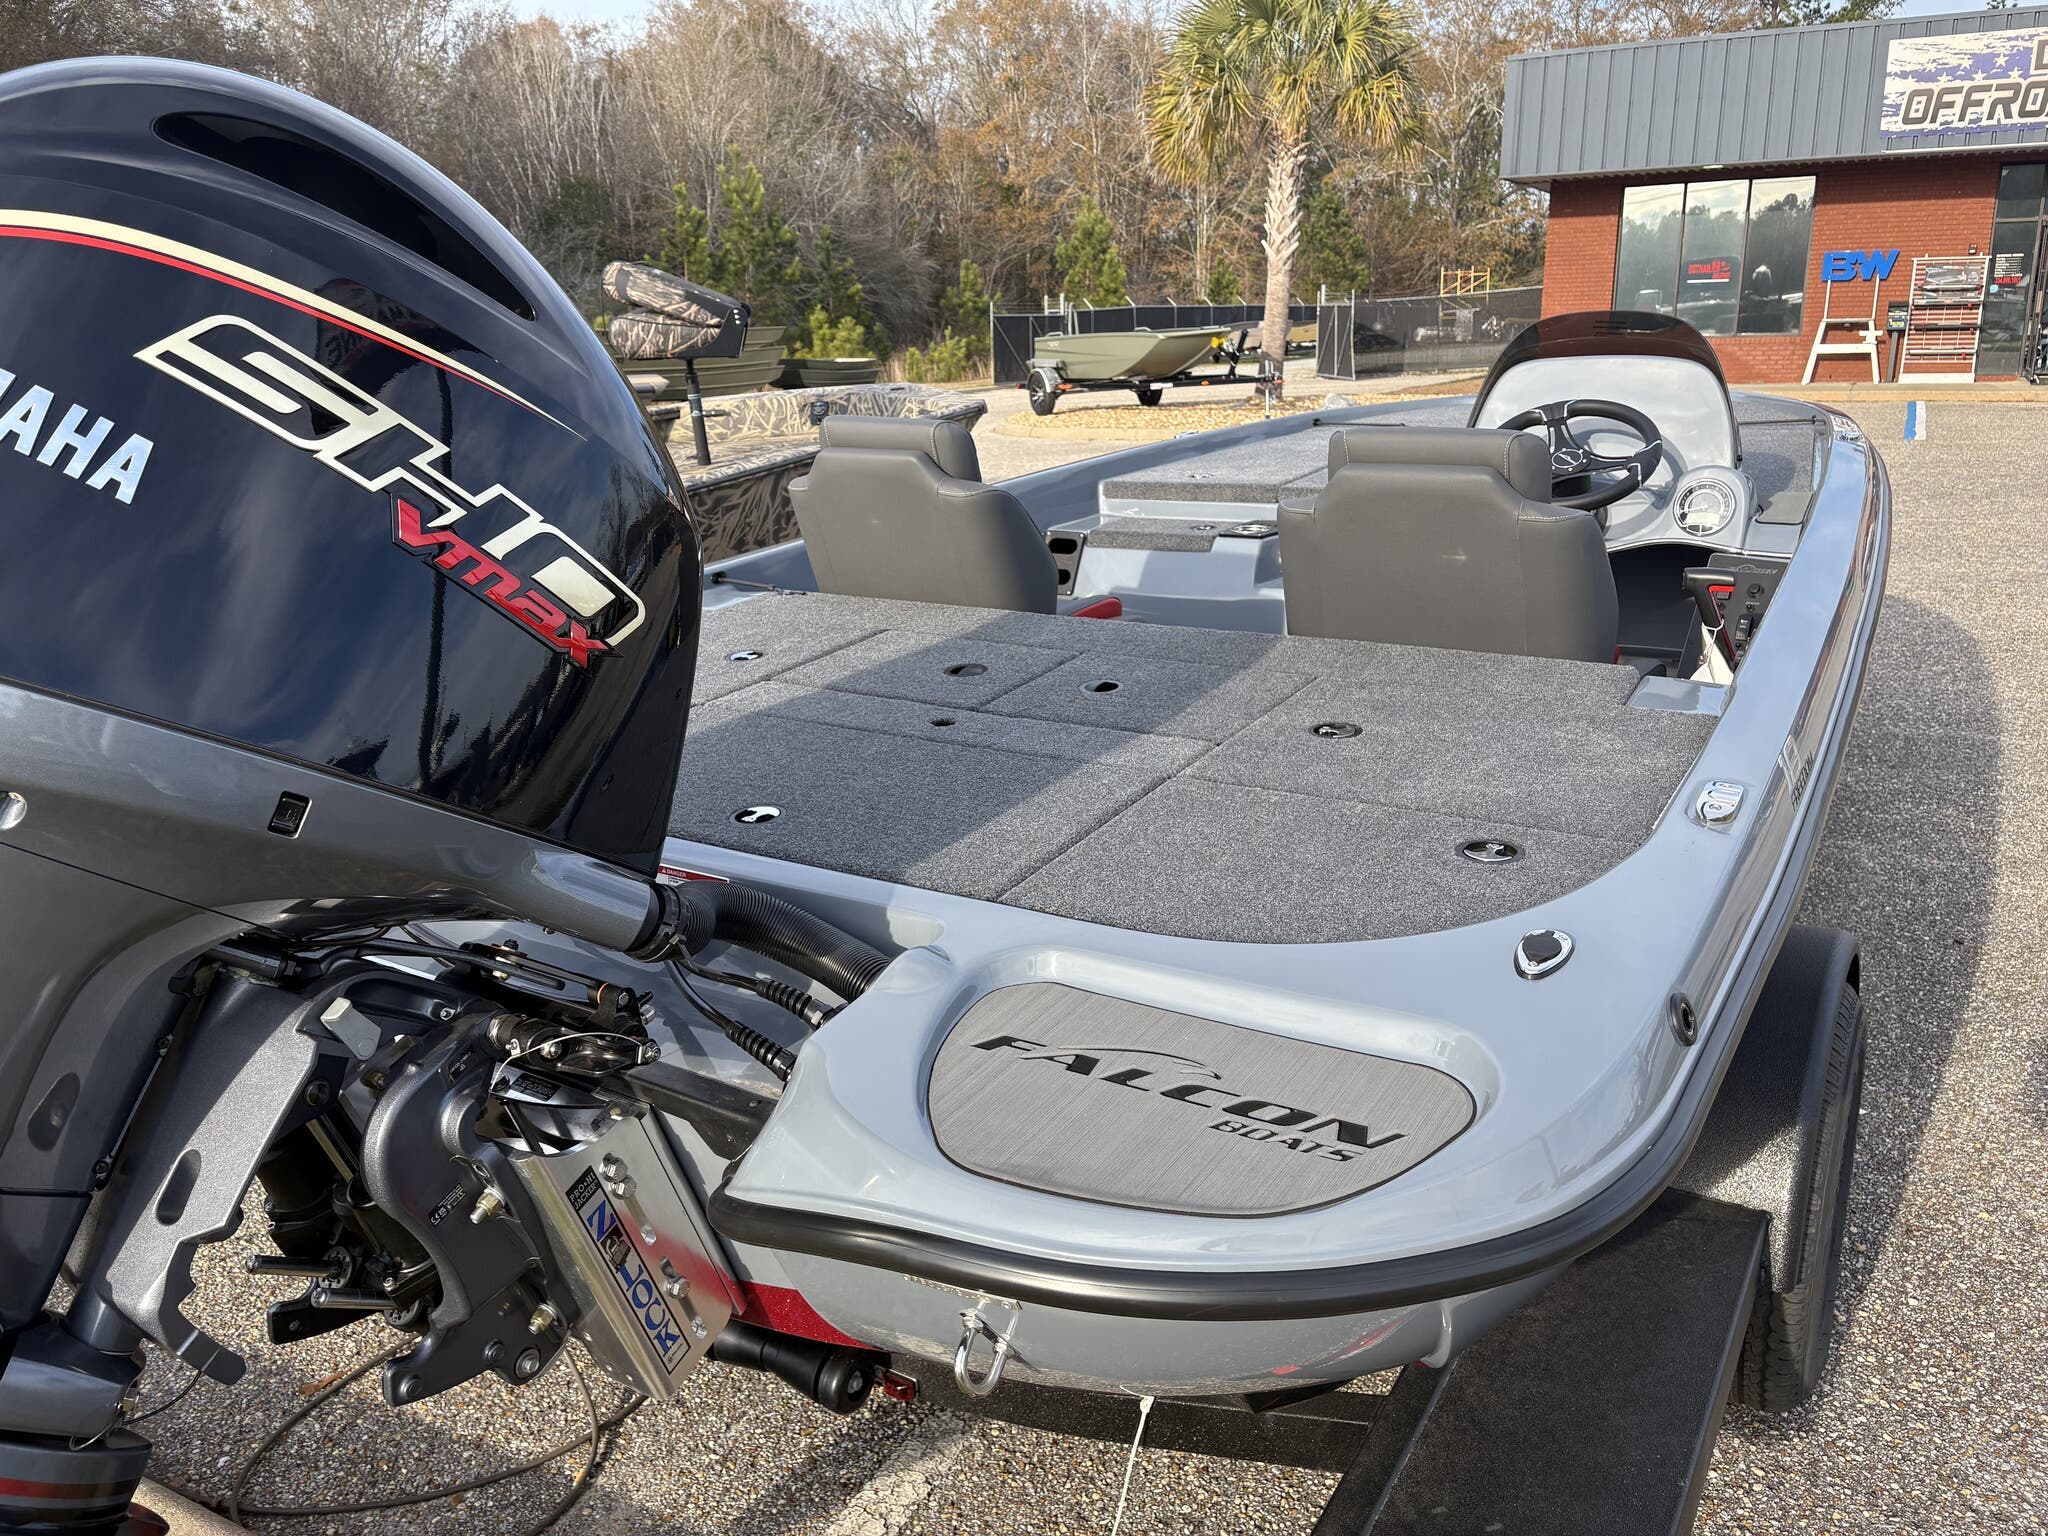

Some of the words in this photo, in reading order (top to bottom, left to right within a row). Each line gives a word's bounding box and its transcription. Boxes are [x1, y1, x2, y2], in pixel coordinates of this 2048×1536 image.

[1901, 82, 2048, 126] OFFRO
[134, 314, 646, 648] SHO
[970, 1034, 1408, 1149] FALCON
[1208, 1120, 1362, 1161] BOATS
[586, 1199, 617, 1243] Z
[617, 1262, 681, 1358] LOCK
